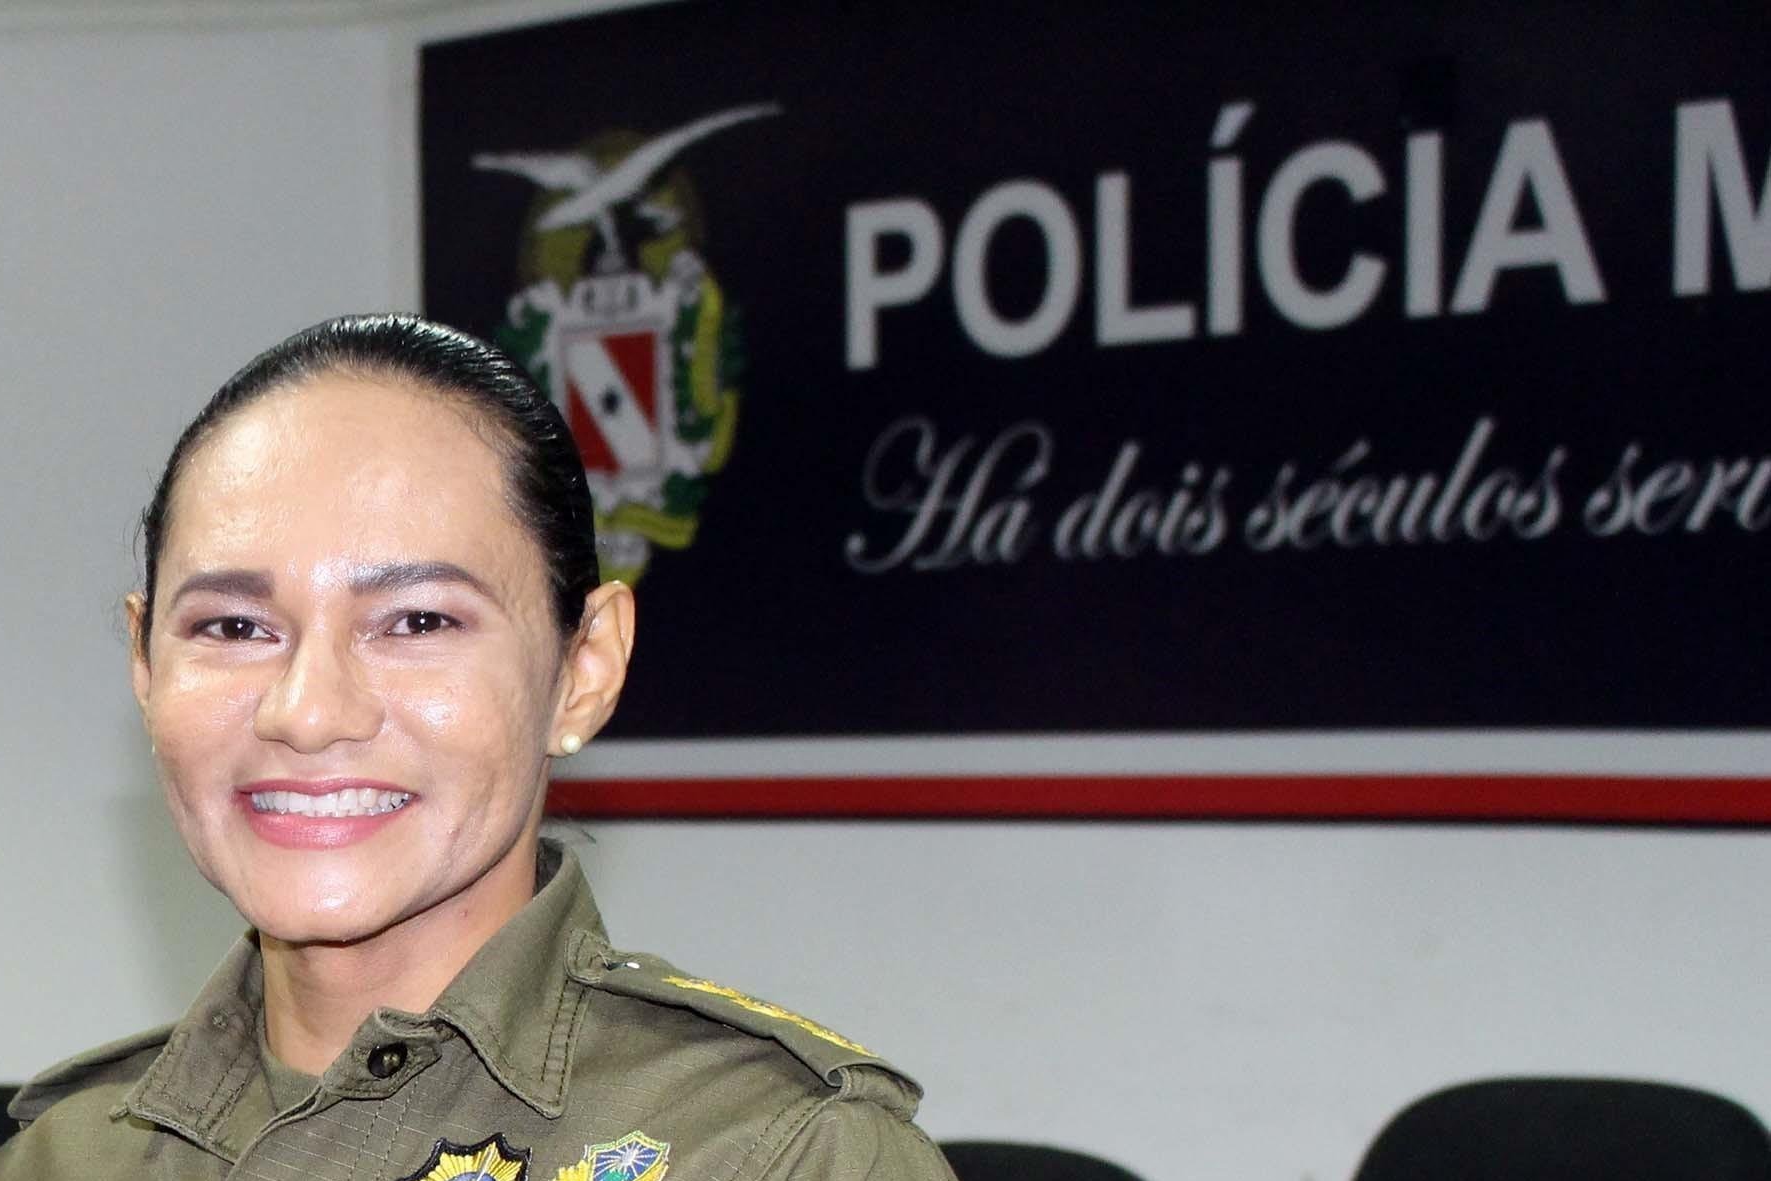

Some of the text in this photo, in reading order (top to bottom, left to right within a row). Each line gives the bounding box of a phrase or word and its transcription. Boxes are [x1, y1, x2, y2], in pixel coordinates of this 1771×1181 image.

[844, 102, 1608, 371] POLÍCIA
[1053, 438, 1228, 560] dois
[1244, 415, 1568, 552] séculos
